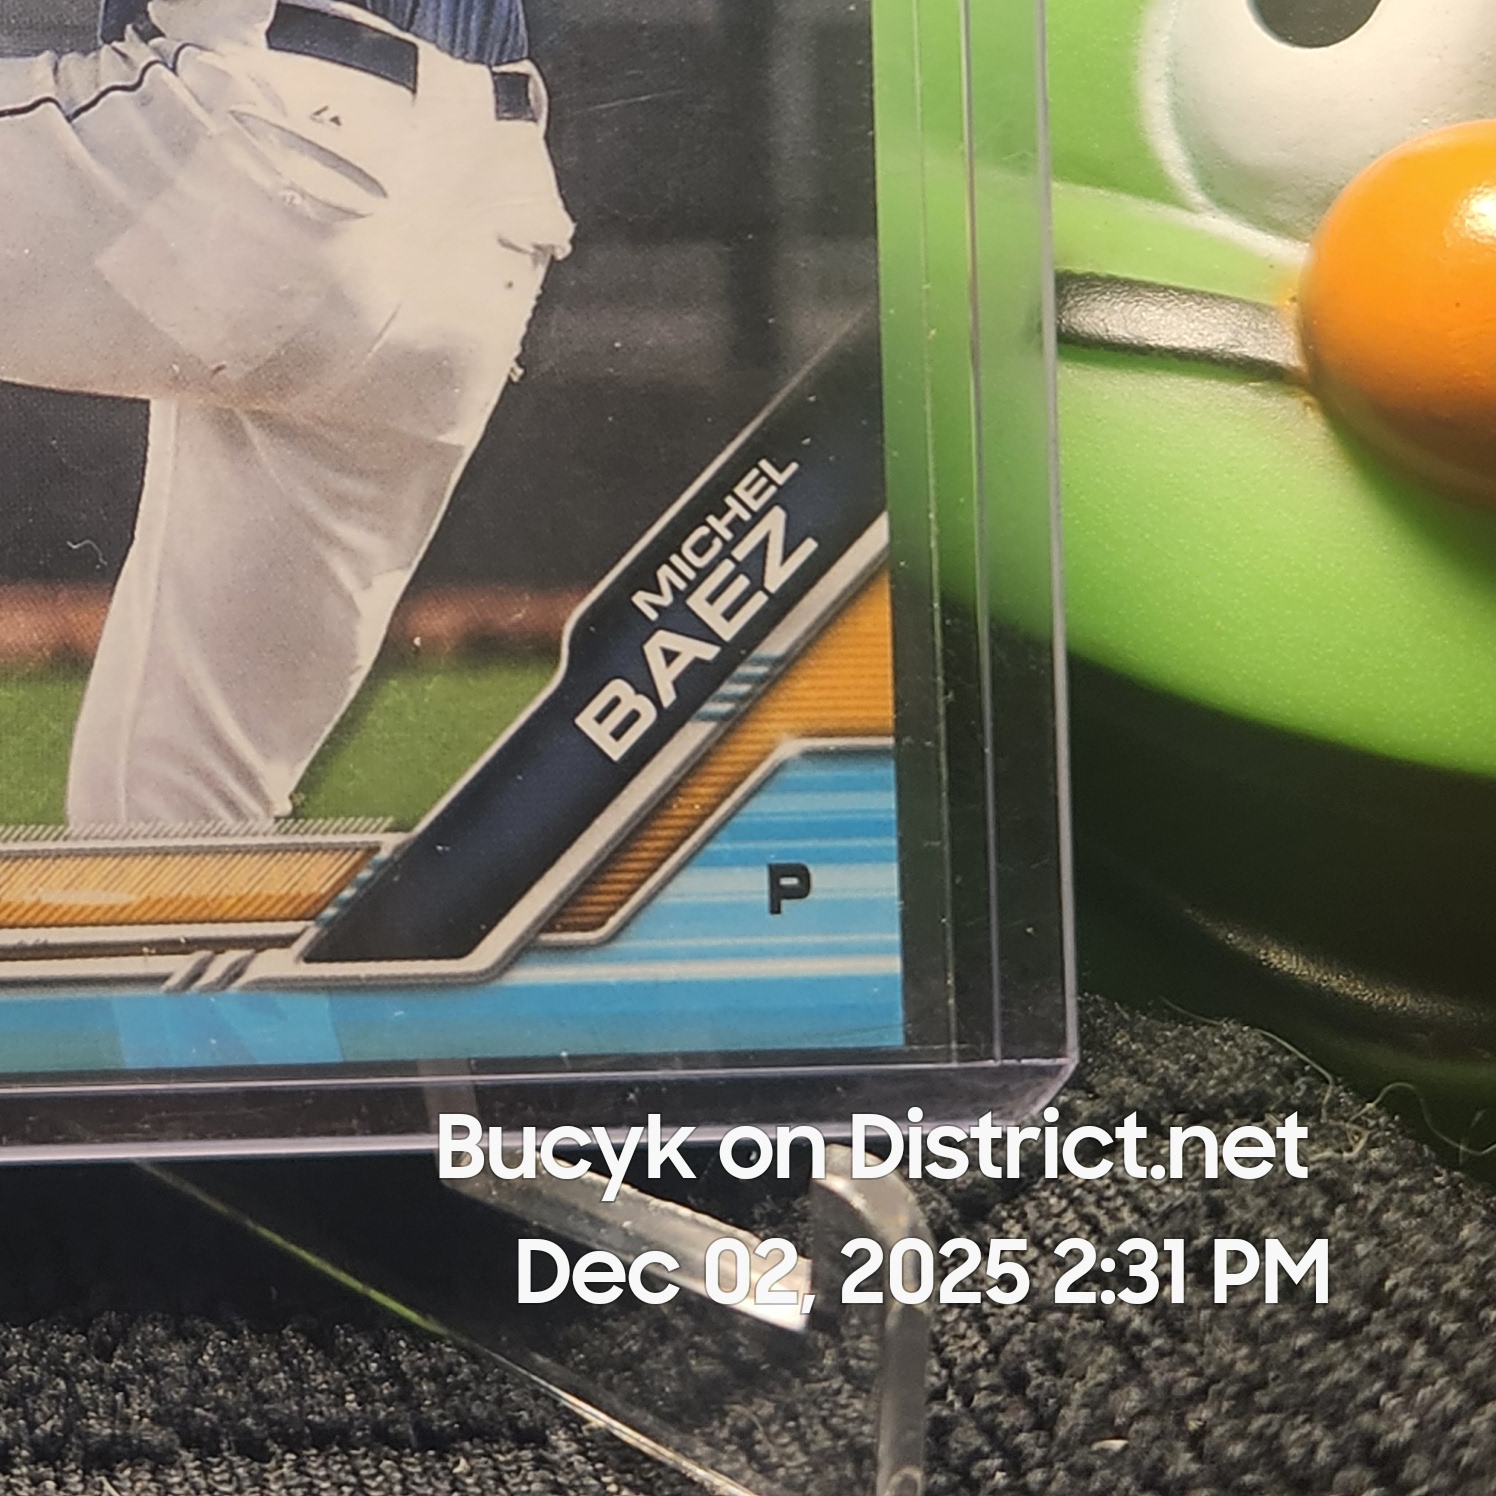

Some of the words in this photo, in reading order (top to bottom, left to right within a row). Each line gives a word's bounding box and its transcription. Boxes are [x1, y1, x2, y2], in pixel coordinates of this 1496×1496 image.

[630, 457, 800, 622] MICHEL
[573, 504, 819, 763] BAEZ
[767, 862, 813, 916] P
